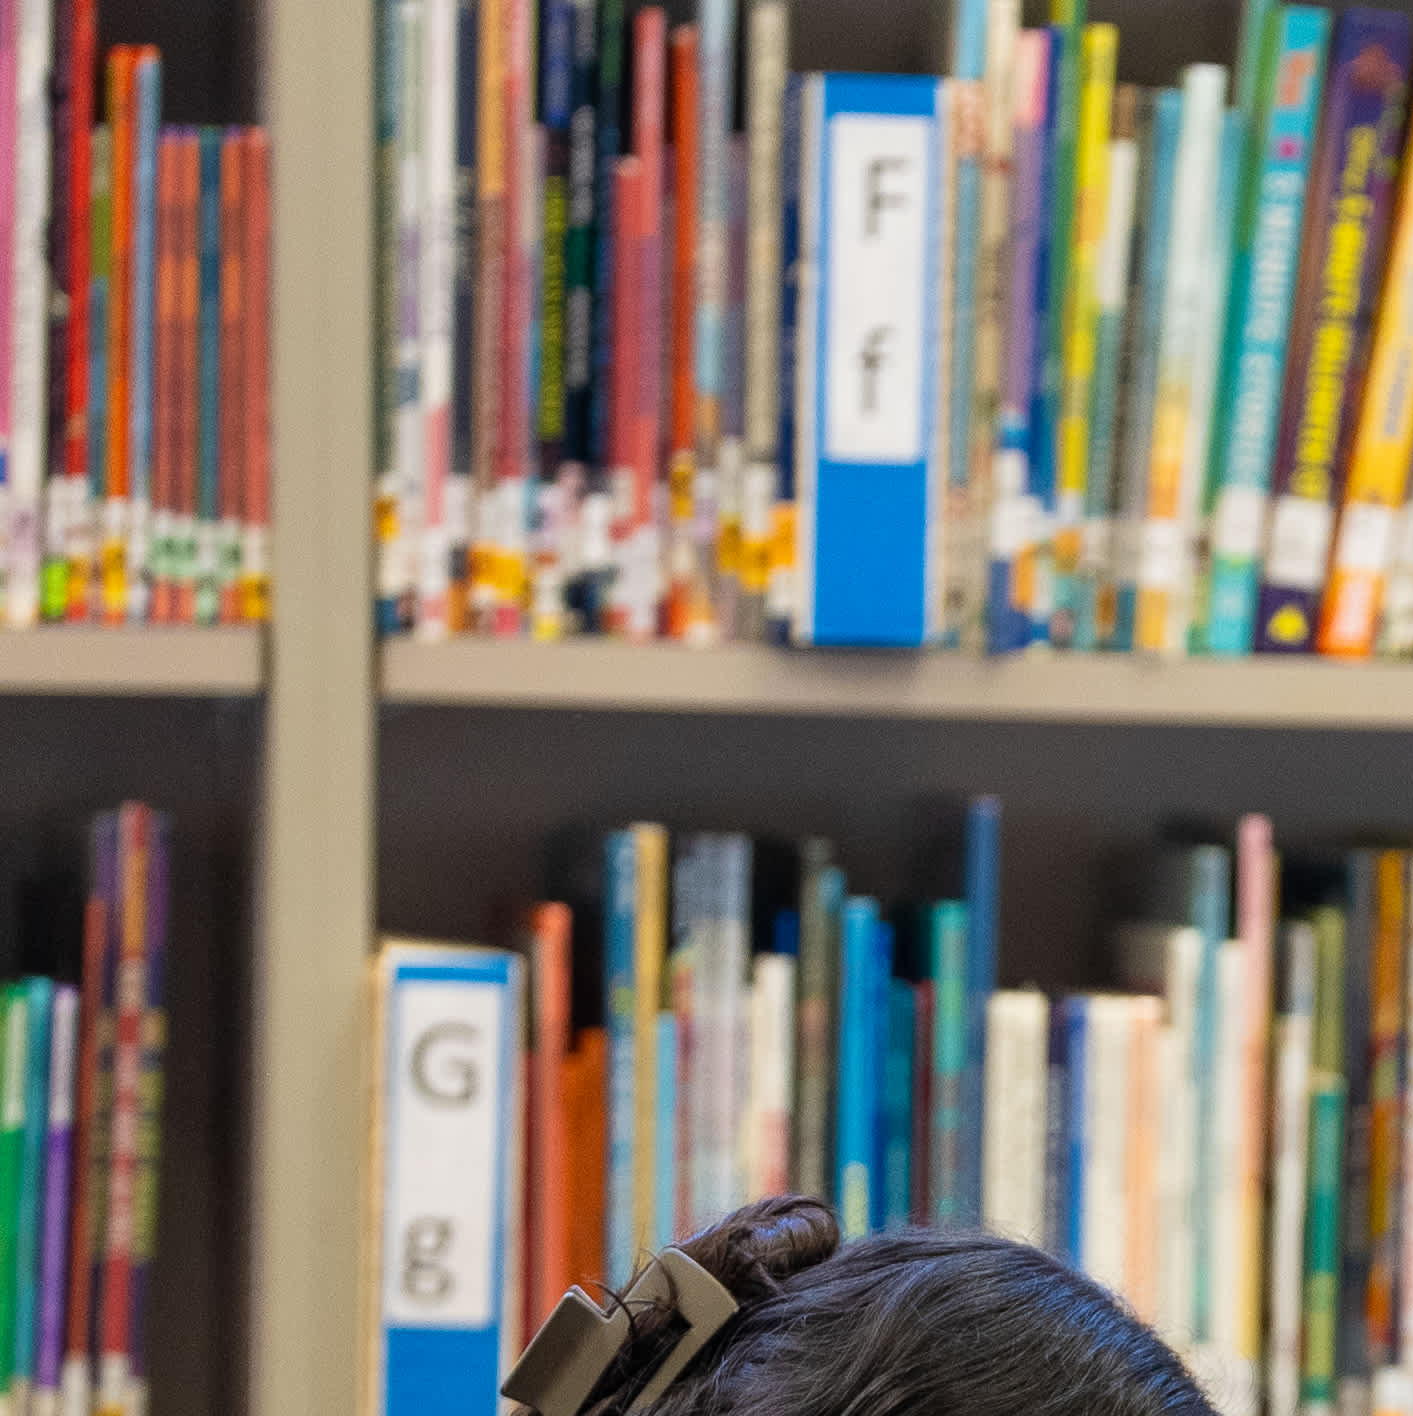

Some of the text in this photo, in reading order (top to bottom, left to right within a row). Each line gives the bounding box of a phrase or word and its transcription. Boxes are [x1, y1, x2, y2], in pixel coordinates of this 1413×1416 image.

[862, 155, 912, 238] F
[856, 322, 898, 415] f
[409, 1019, 484, 1113] G
[401, 1214, 457, 1307] g
